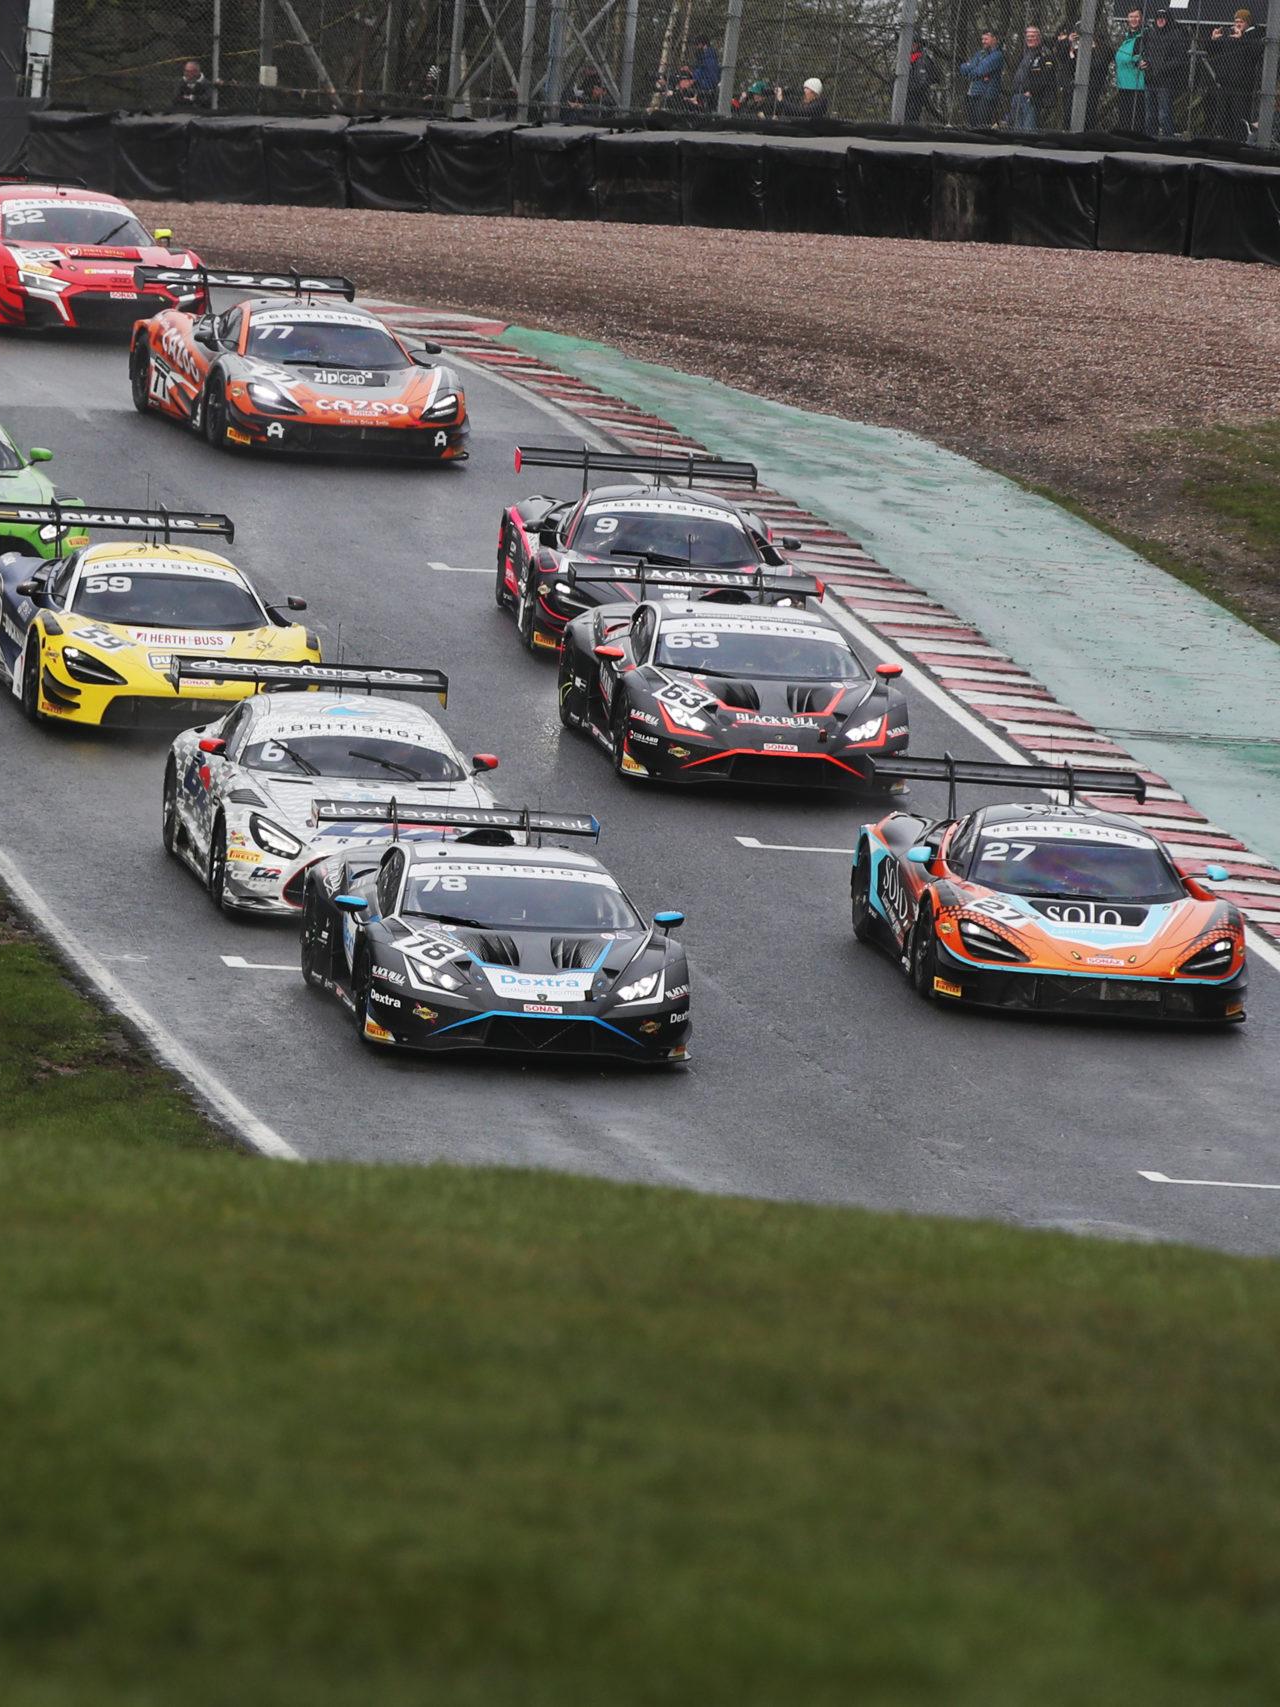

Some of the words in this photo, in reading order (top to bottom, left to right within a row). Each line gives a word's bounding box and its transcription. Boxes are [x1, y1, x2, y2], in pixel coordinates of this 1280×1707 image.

[6, 209, 46, 226] 32
[21, 250, 57, 260] 32
[255, 325, 295, 340] 77
[162, 327, 200, 384] CAZOO
[153, 364, 168, 400] 77
[315, 399, 410, 414] CAZOO
[601, 501, 734, 518] #BRITISHGT
[17, 509, 199, 528] DUCKHAMS
[593, 517, 619, 534] 9
[92, 562, 230, 577] #BRITISHGT
[613, 567, 699, 582] BLACK
[85, 576, 132, 594] 59
[681, 622, 818, 635] #BRITISHGT
[71, 626, 126, 650] 59
[150, 634, 186, 646] HERTH
[194, 635, 224, 646] BUSS
[664, 631, 720, 649] 63
[180, 678, 211, 686] SONAX
[661, 683, 709, 709] 63
[735, 713, 781, 725] BLACK
[781, 716, 820, 730] BULL
[276, 723, 425, 741] #BRITISHGT
[260, 741, 289, 762] 6
[765, 743, 797, 751] SONAX
[320, 802, 592, 831] dextagroup.o.uk
[992, 826, 1143, 842] #BRITISHGT
[229, 850, 260, 862] PIRELLI
[981, 842, 1037, 862] 27
[433, 864, 590, 879] #BRITISHGT
[415, 876, 468, 893] 78
[972, 900, 1026, 921] 27
[1046, 901, 1123, 926] solo
[404, 932, 456, 961] 78
[500, 975, 579, 987] Dextra
[935, 979, 961, 995] PIRELLI
[370, 988, 402, 1009] Dextra
[525, 1004, 560, 1013] SONAX
